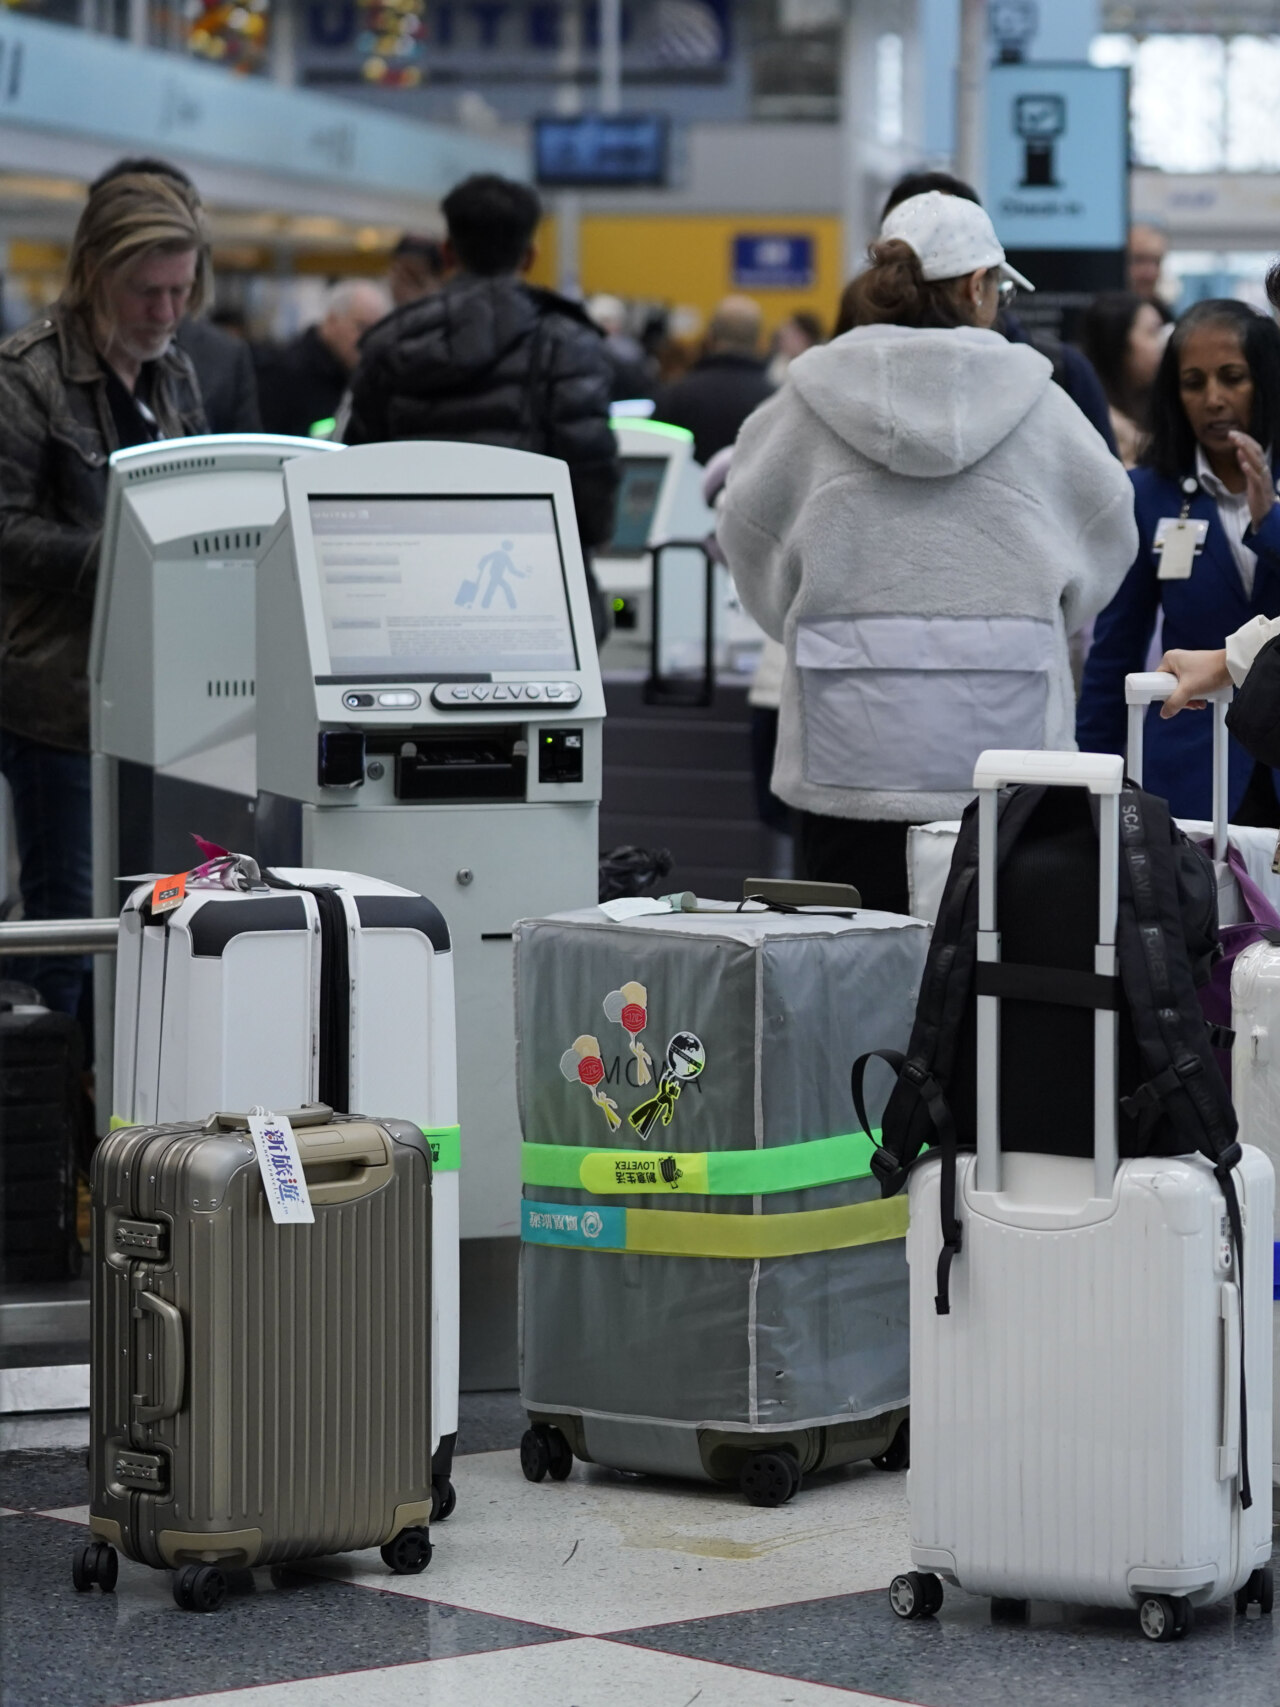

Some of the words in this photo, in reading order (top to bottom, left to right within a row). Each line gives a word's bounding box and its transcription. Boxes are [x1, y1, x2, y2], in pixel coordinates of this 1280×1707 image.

[615, 1161, 655, 1170] LOVETEX
[615, 1171, 657, 1184] 創意生活
